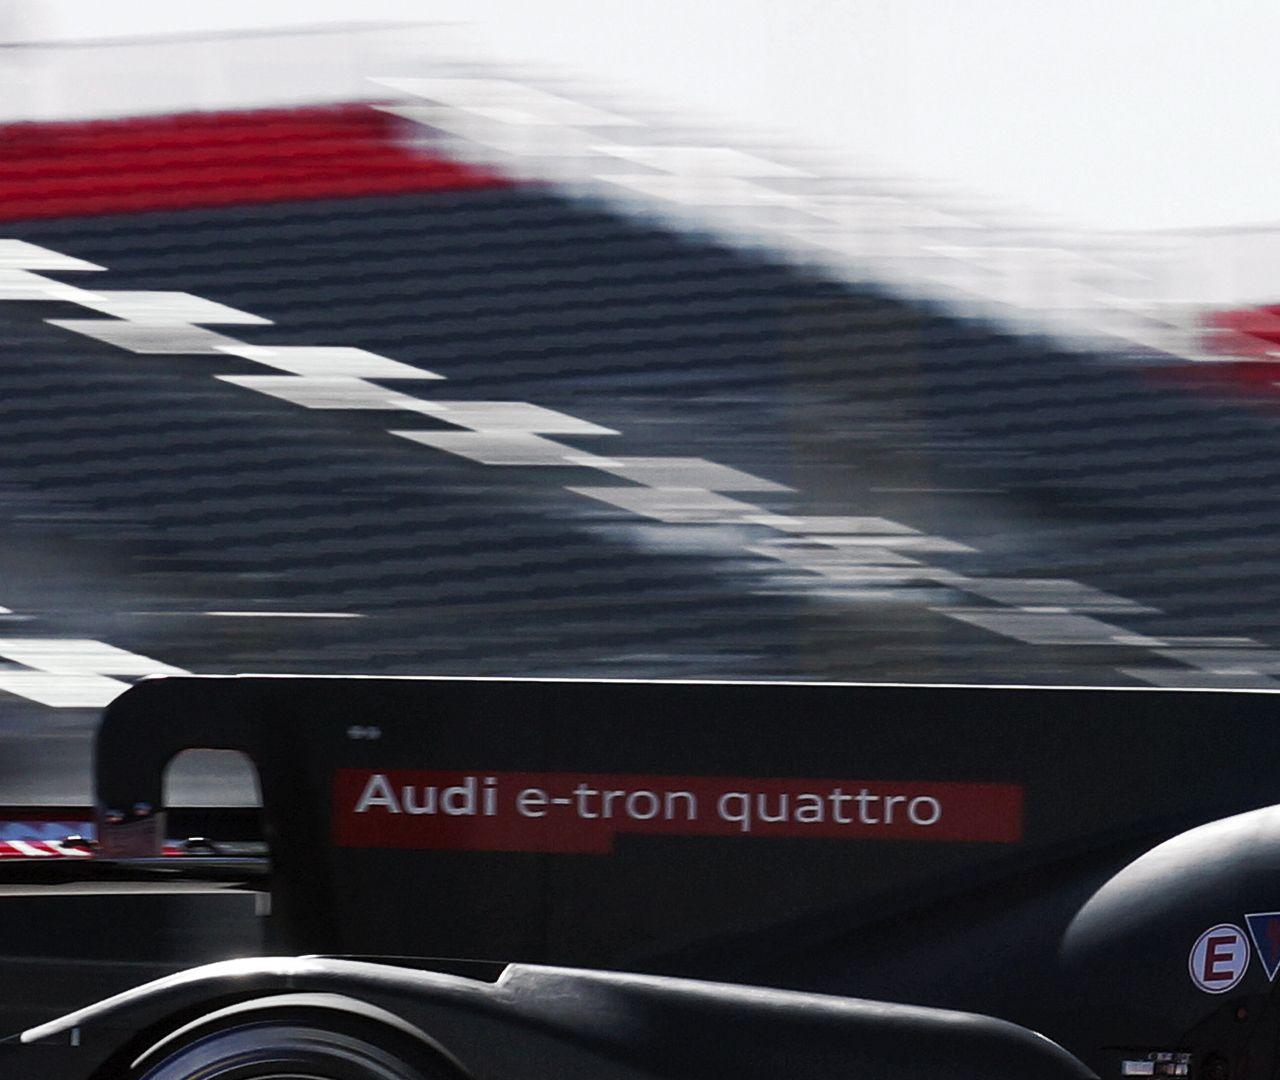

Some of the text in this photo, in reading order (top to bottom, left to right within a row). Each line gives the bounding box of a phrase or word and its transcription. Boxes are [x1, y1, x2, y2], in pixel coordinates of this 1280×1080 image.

[355, 774, 943, 831] Audi e-tron quattro
[1203, 935, 1237, 982] E
